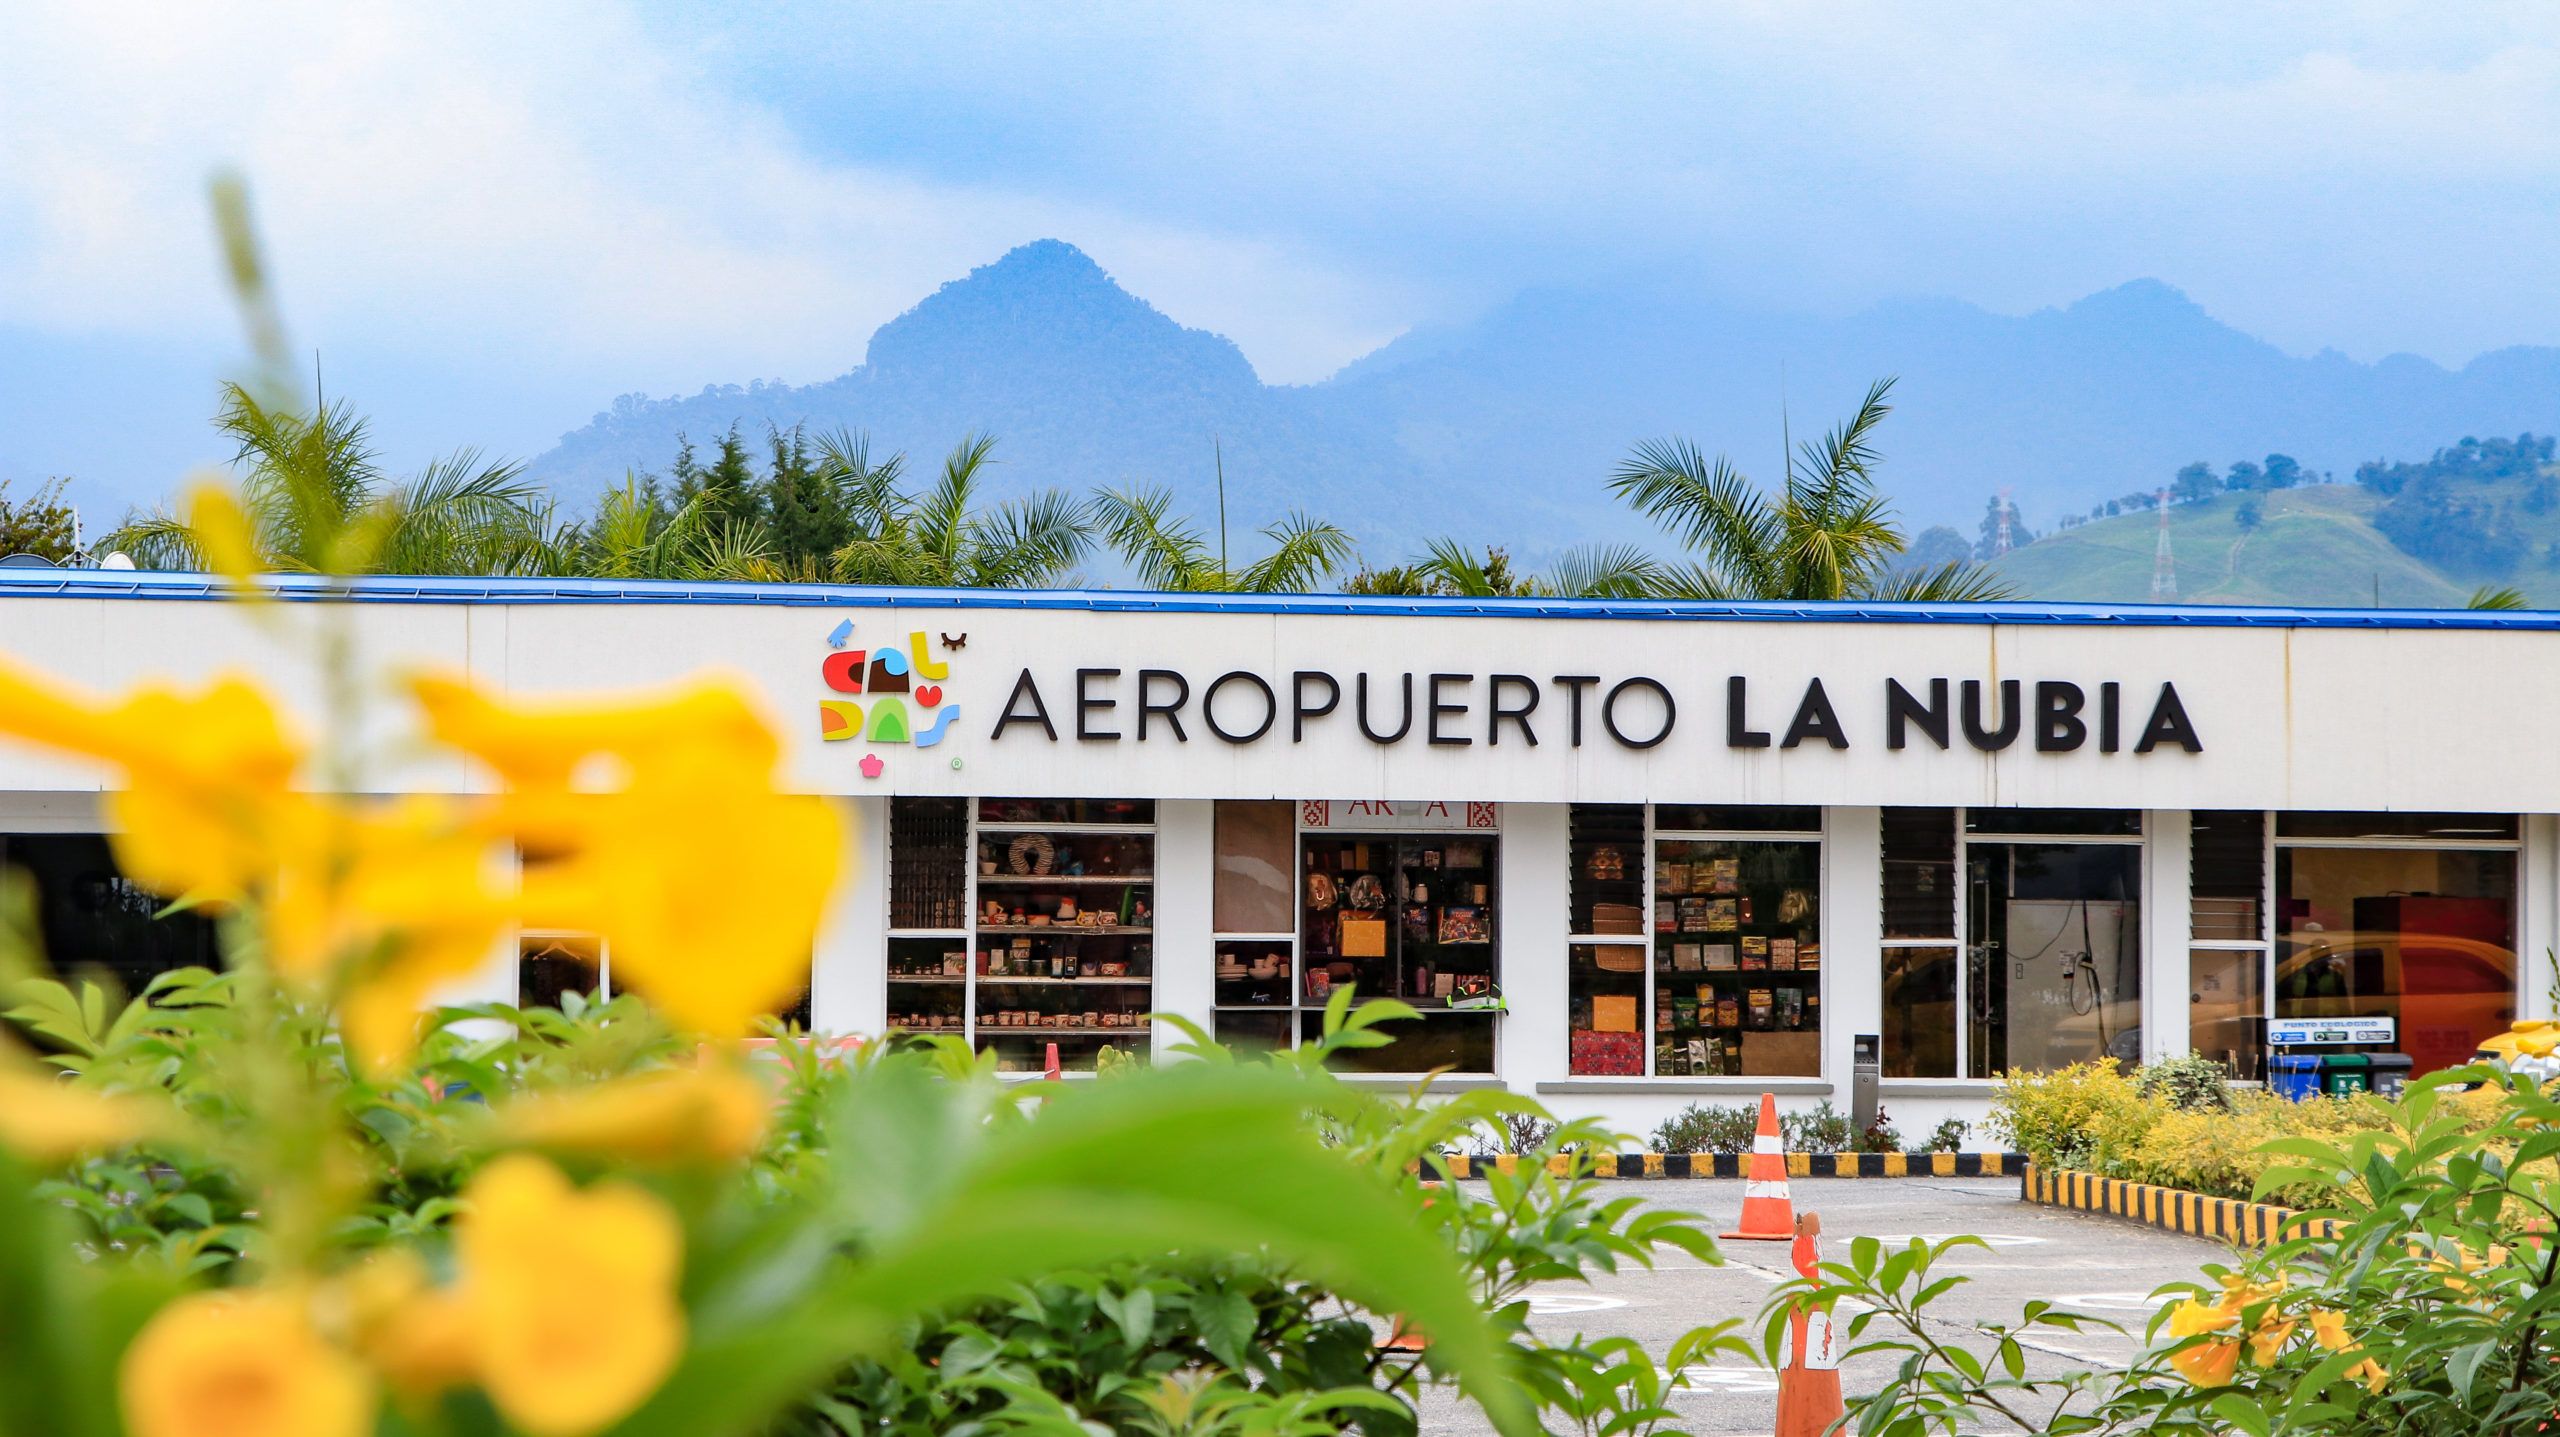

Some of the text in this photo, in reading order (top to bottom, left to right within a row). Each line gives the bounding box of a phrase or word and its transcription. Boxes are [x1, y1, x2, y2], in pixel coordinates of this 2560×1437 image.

[990, 667, 2205, 755] AEROPUERTO LA NUBIA
